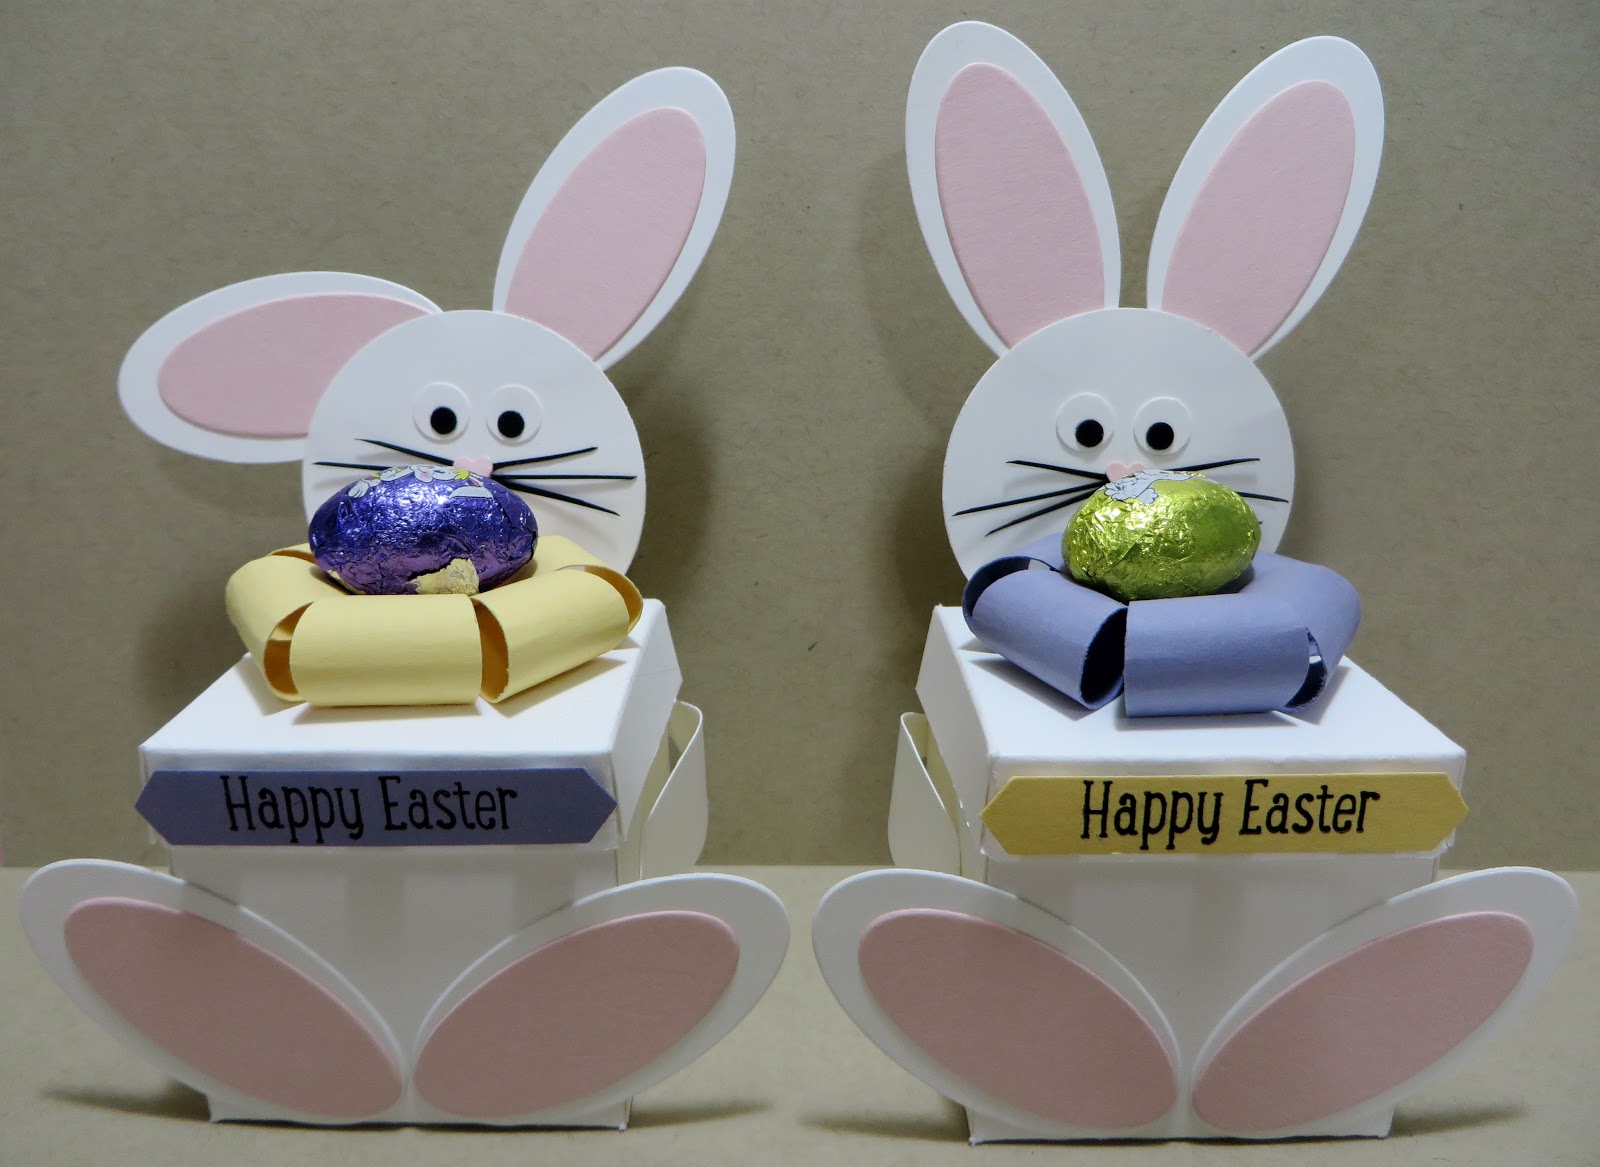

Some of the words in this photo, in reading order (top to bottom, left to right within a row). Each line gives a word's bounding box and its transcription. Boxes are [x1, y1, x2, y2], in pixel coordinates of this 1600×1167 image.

[220, 775, 364, 844] Happy
[378, 775, 518, 832] Easter
[1080, 779, 1224, 850] Happy
[1238, 778, 1381, 836] Easter
